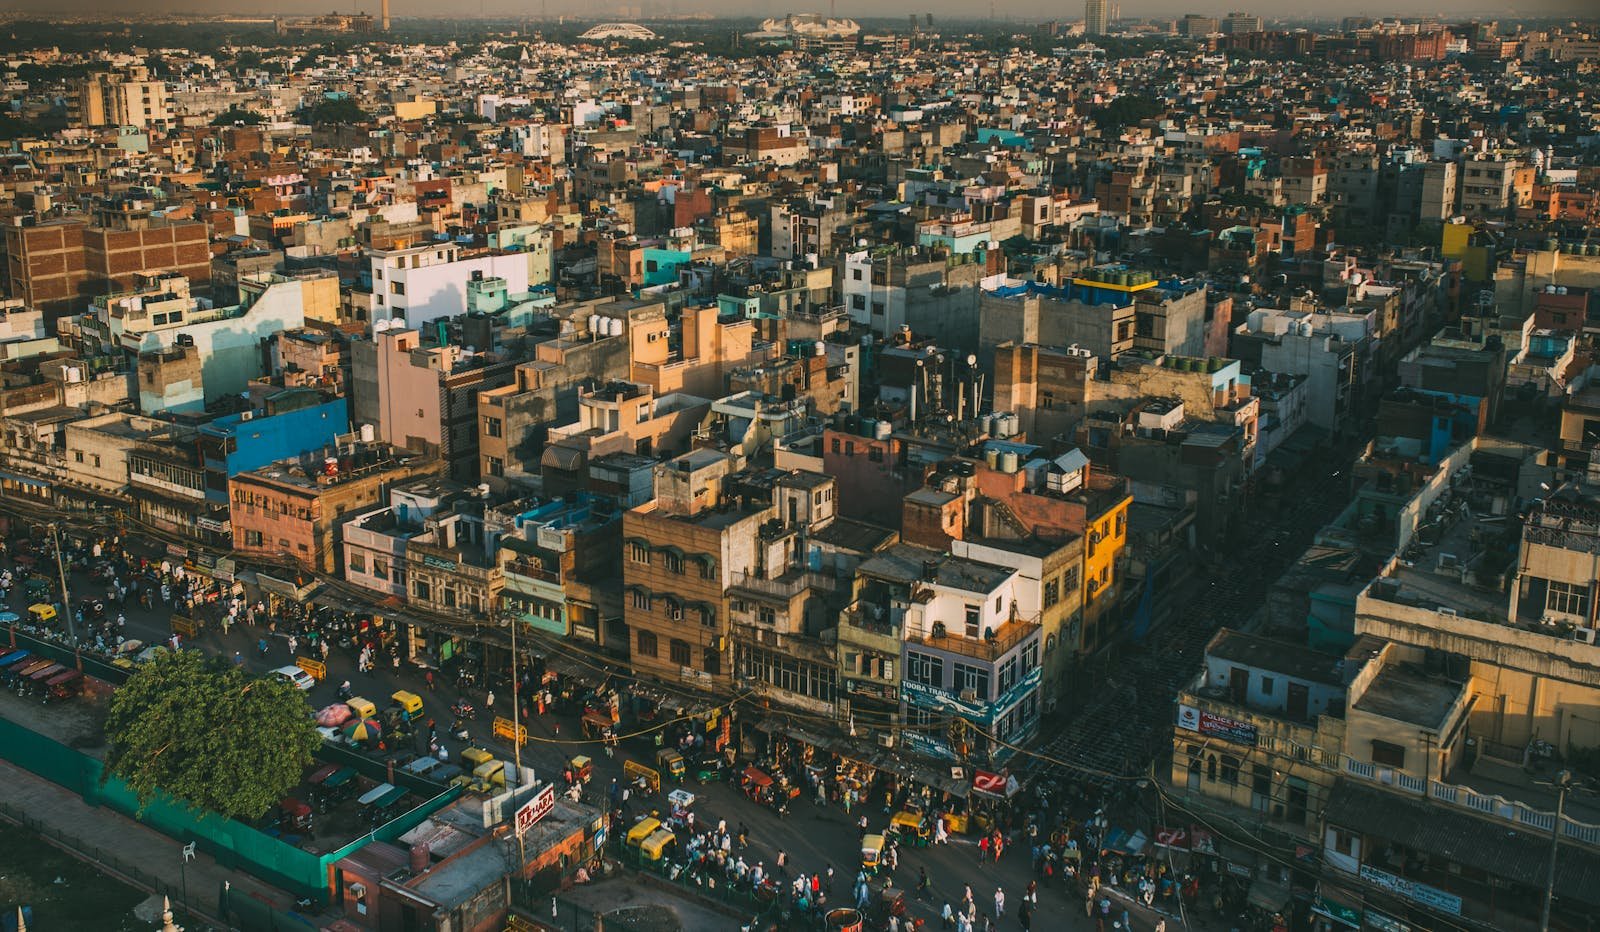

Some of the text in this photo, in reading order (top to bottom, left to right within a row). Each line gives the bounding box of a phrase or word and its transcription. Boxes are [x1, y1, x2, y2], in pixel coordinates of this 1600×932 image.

[902, 681, 927, 693] TOOBA
[1202, 711, 1232, 723] POLICE
[1233, 721, 1256, 730] POST
